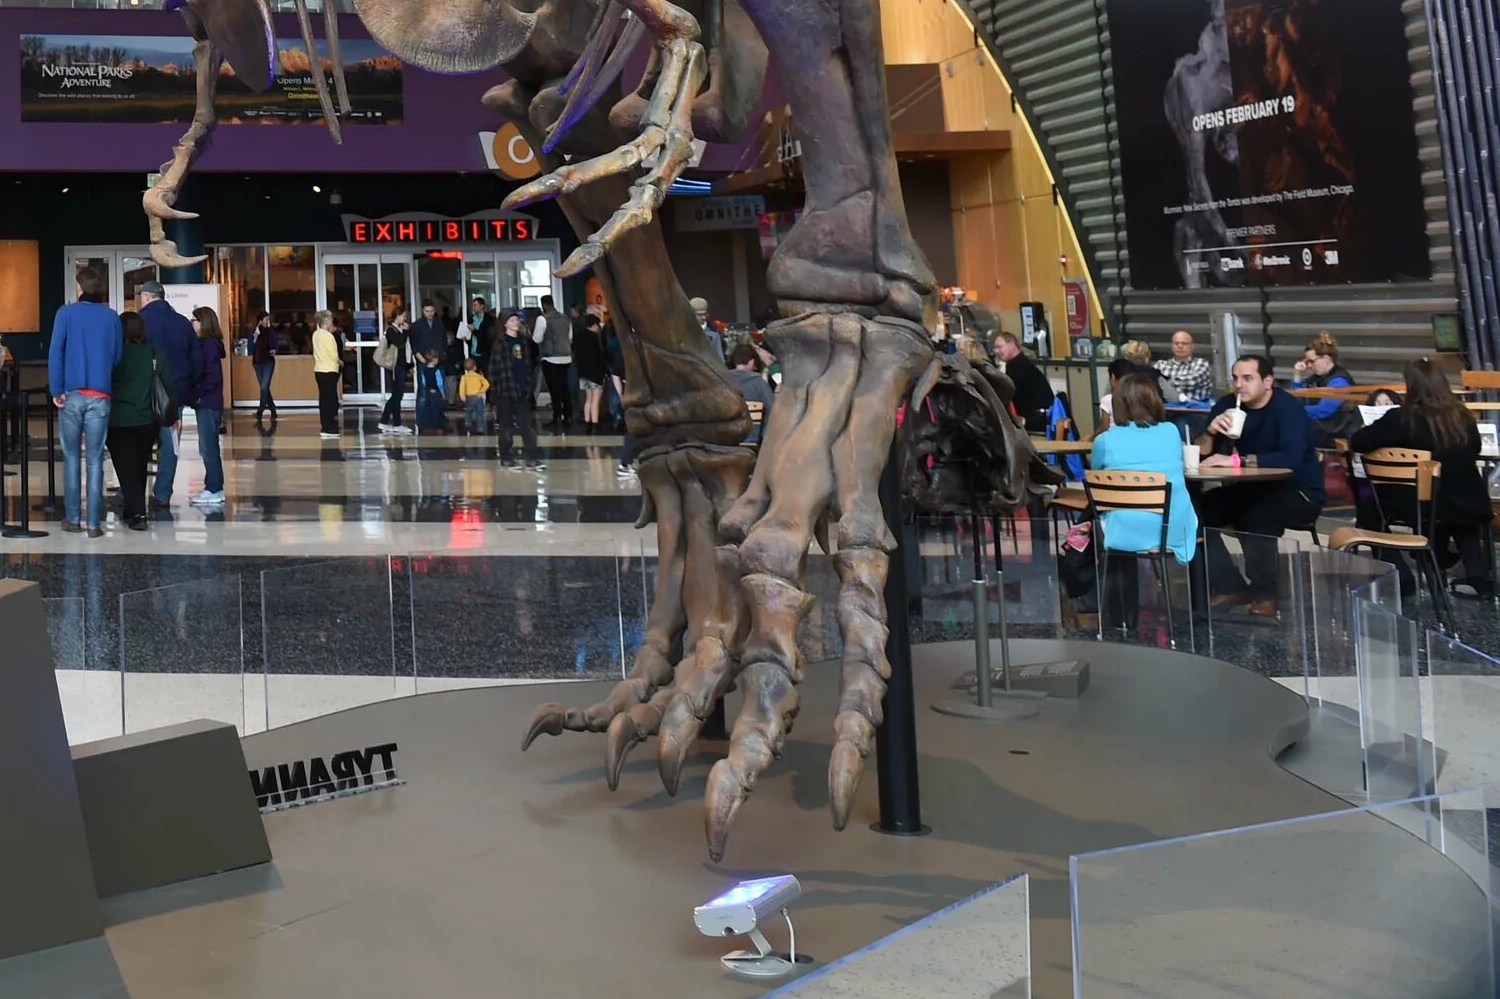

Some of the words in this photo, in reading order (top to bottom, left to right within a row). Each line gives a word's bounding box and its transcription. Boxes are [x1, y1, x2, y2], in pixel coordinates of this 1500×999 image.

[41, 64, 97, 78] NATIONAL
[98, 65, 133, 80] PARKS
[60, 77, 112, 89] ADVENTURE
[1192, 110, 1225, 131] OPENS
[1225, 99, 1280, 125] FEBRUARY
[1281, 95, 1295, 113] 19
[355, 220, 528, 241] EXHIBITS
